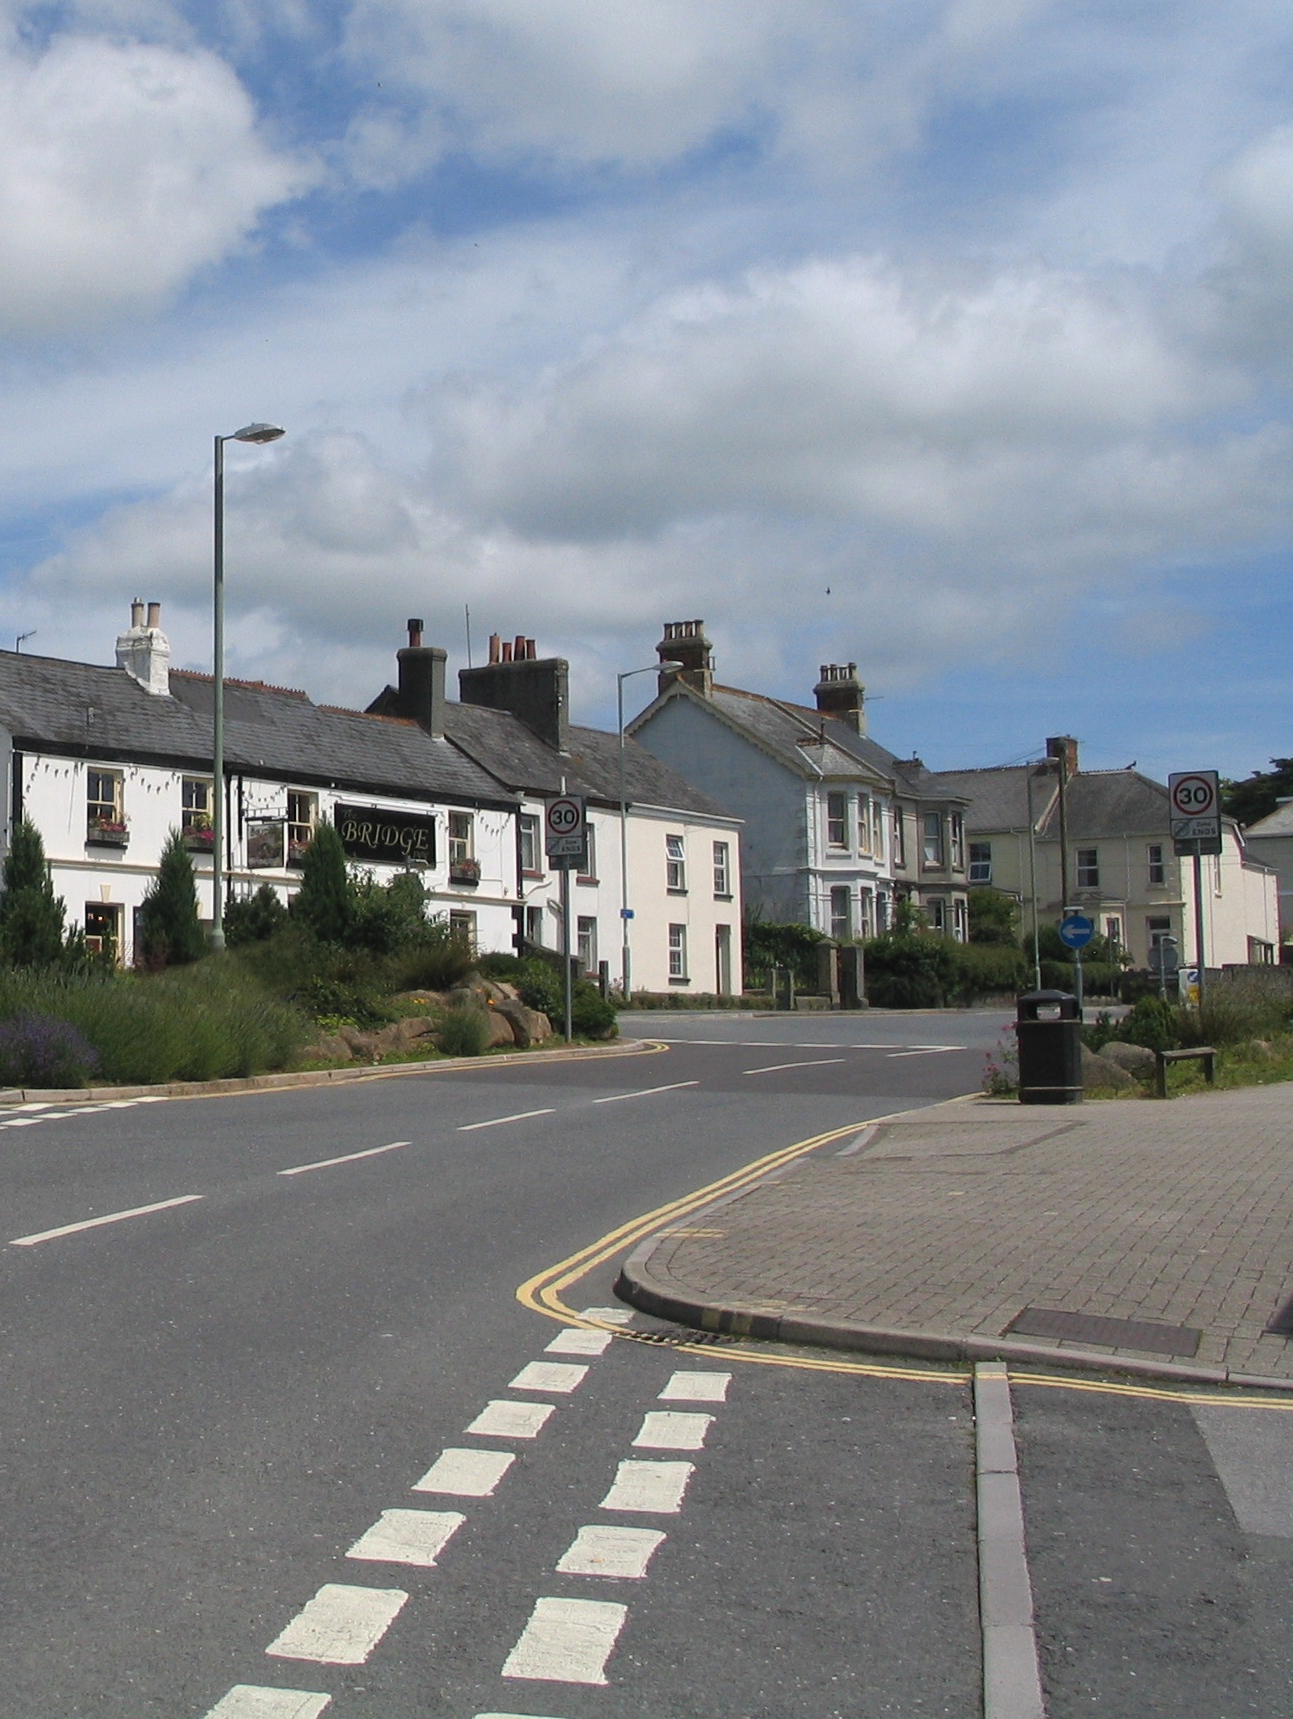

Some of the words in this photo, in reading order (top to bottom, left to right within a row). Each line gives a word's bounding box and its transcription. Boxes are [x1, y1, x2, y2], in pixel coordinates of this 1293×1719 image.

[1179, 787, 1207, 805] 30
[552, 810, 575, 825] 30
[341, 820, 429, 855] BRIDGE
[1192, 827, 1216, 836] ENDS
